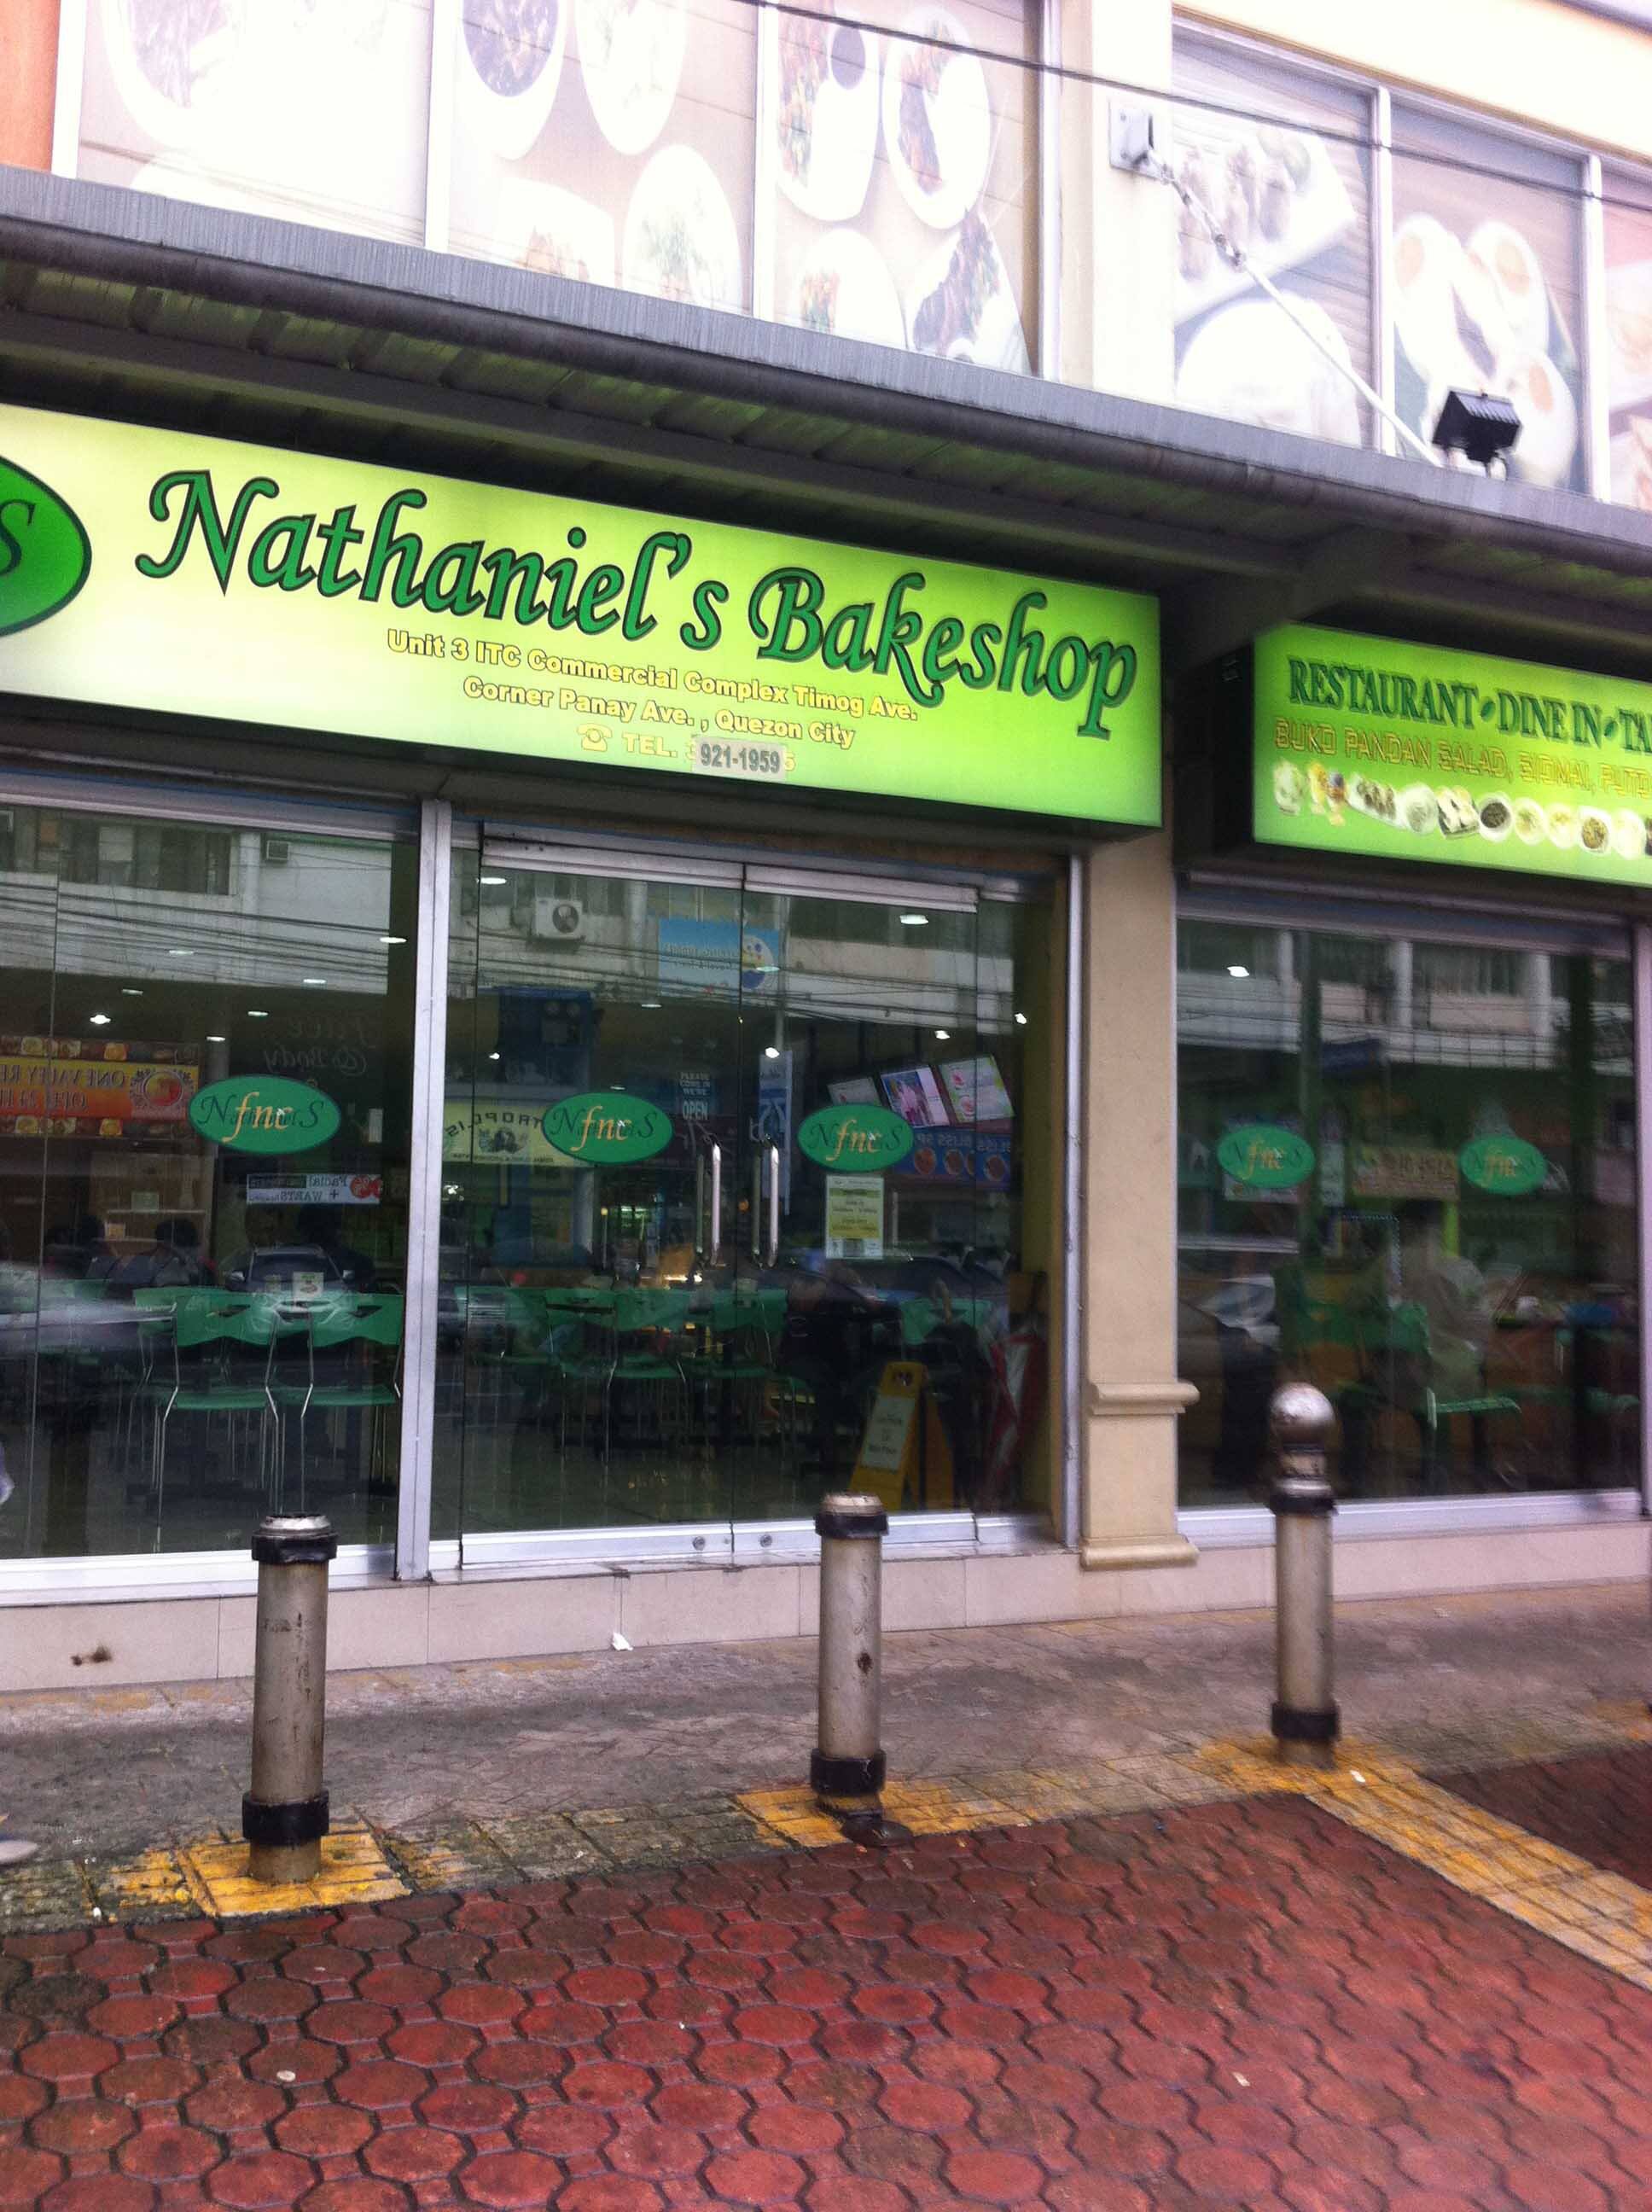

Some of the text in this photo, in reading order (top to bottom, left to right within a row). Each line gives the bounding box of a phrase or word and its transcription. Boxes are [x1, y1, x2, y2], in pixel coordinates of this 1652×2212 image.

[135, 469, 1137, 740] Nathaniel's Bakeshop
[387, 629, 918, 720] Unit 3 ITC Commercial Complex Timog Ave.
[1287, 655, 1652, 755] RESTAURANT DINE IN TA
[463, 676, 554, 707] Corner
[559, 688, 636, 723] Panay
[641, 699, 695, 725] Ave.
[715, 708, 803, 740] Quezon
[808, 722, 856, 749] City
[1275, 716, 1338, 756] BUKO
[1344, 726, 1432, 769] PANDAN
[622, 731, 678, 759] TEL.
[700, 742, 781, 775] 921-1959
[682, 1100, 709, 1121] OPEN
